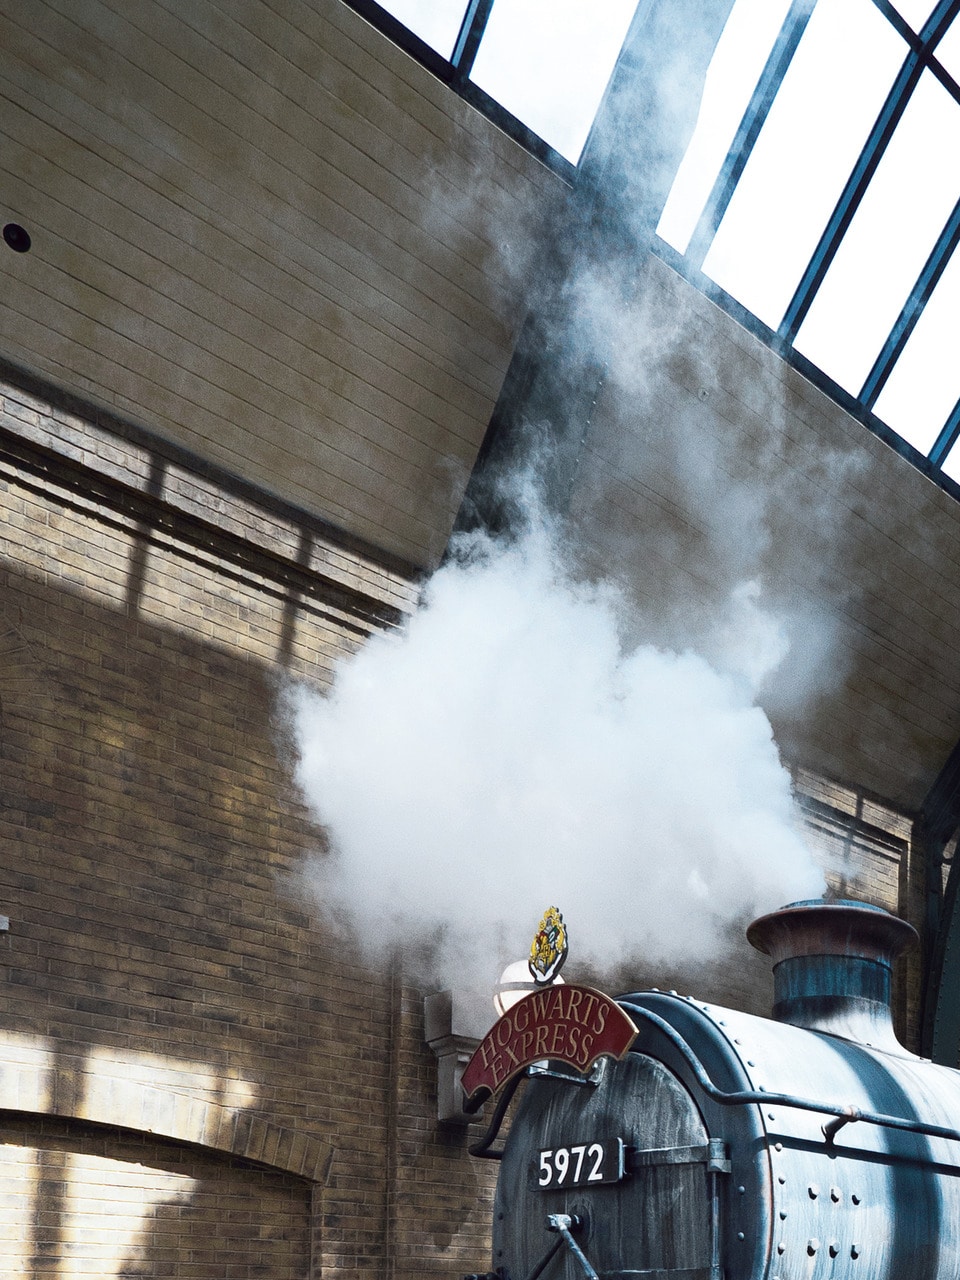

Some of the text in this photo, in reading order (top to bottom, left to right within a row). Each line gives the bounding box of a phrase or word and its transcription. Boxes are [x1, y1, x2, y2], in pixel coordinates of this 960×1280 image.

[480, 989, 610, 1067] HOGWARTS
[489, 1023, 594, 1086] EXPRESS
[539, 1143, 603, 1186] 5972
